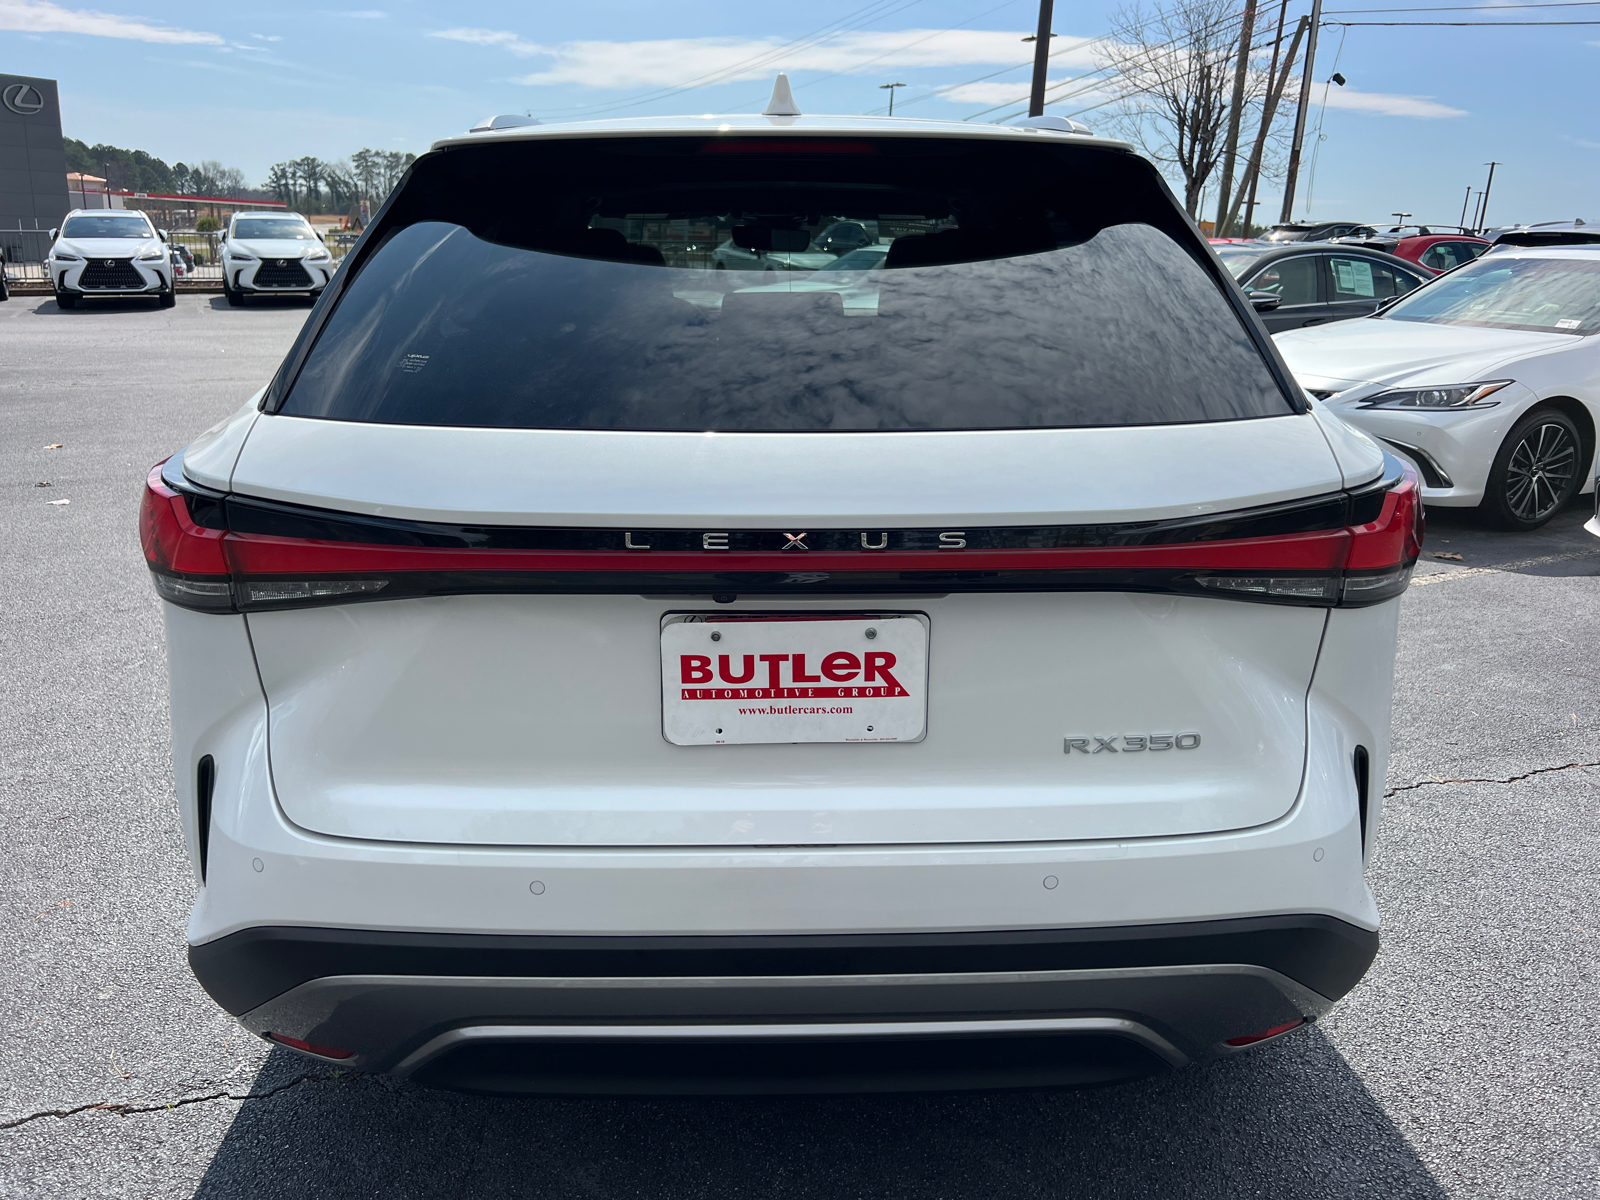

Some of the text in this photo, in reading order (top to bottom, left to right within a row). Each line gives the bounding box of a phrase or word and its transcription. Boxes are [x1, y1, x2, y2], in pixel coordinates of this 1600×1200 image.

[625, 531, 967, 550] LEXUS
[682, 686, 902, 699] AUTOMOTIVE GROUP
[738, 704, 854, 716] www.butlercars.com
[1063, 731, 1202, 755] RX350
